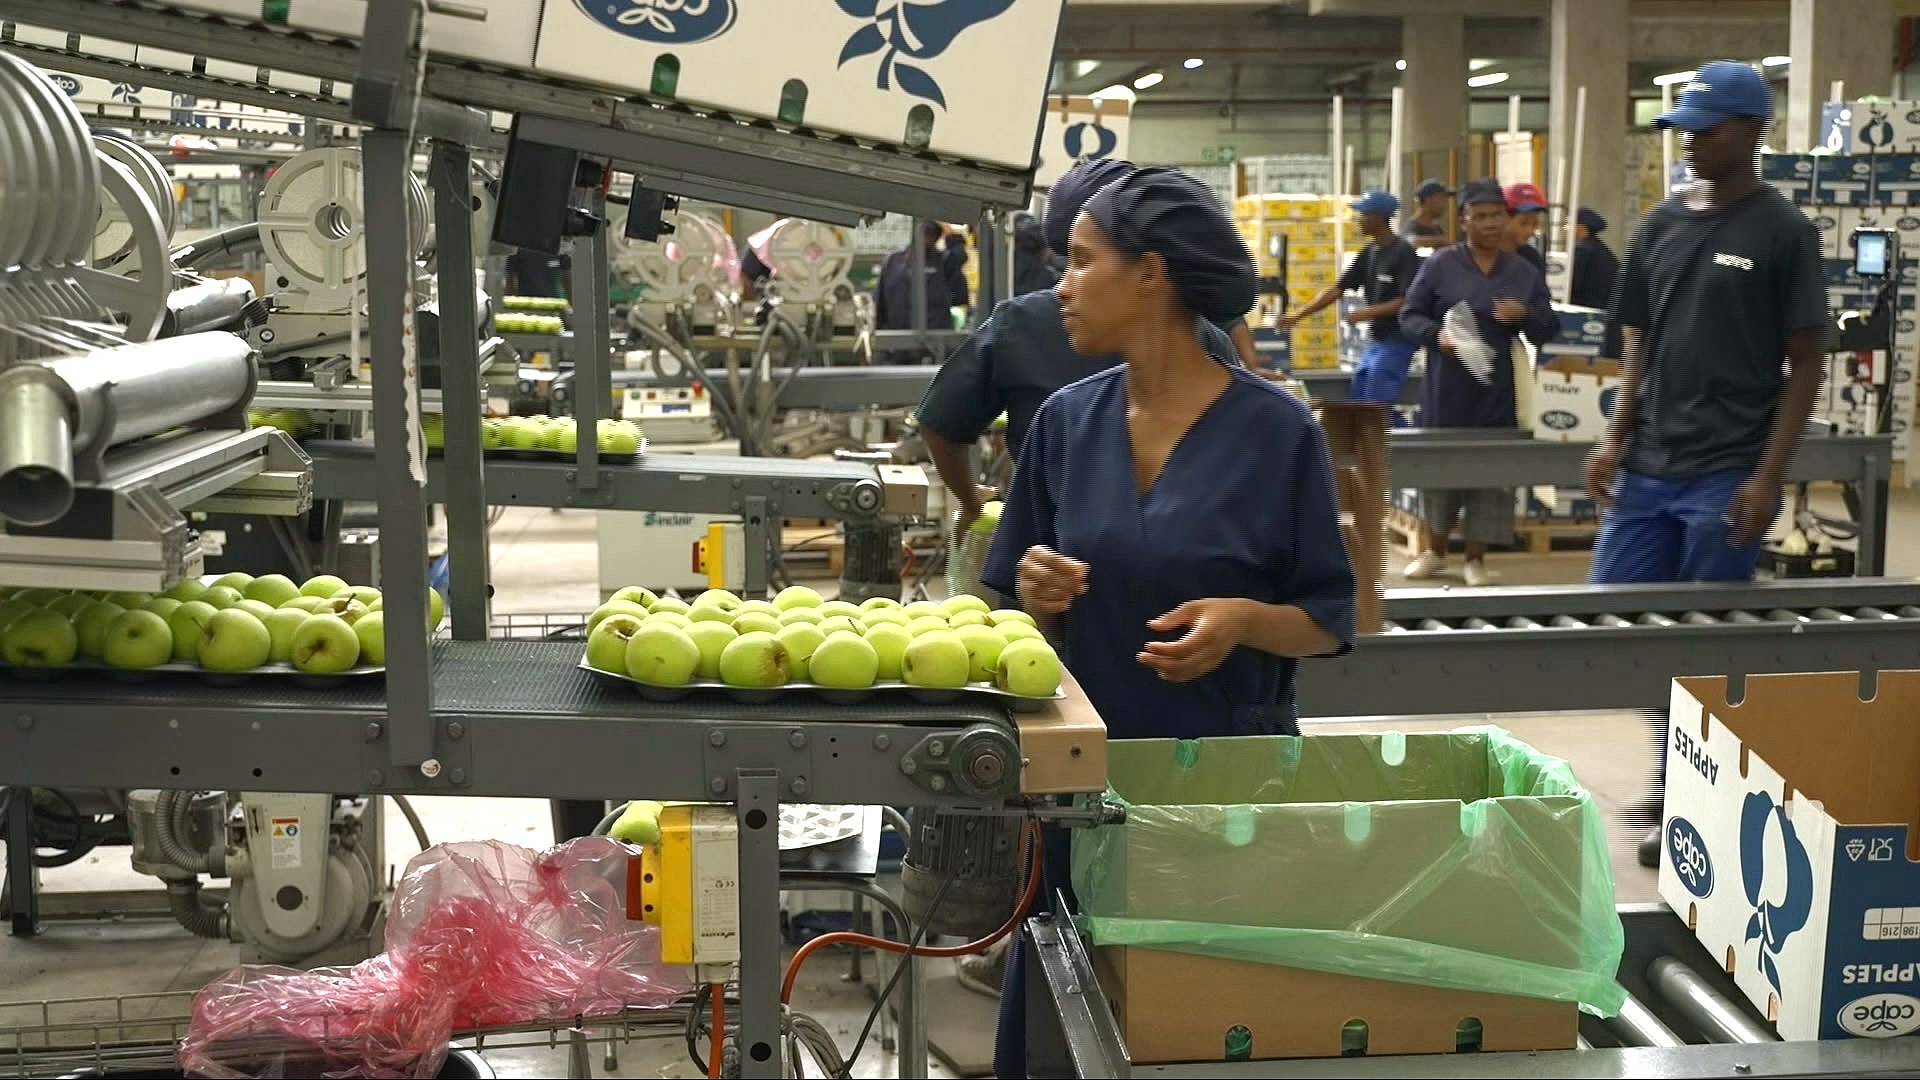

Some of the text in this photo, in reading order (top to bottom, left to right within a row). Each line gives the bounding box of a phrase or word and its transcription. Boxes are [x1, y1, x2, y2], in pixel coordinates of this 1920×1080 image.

[1712, 251, 1755, 272] NOVO
[1675, 726, 1719, 786] APPLES
[1673, 827, 1706, 878] cape
[1882, 926, 1919, 937] 198 216
[1853, 1000, 1915, 1023] cape
